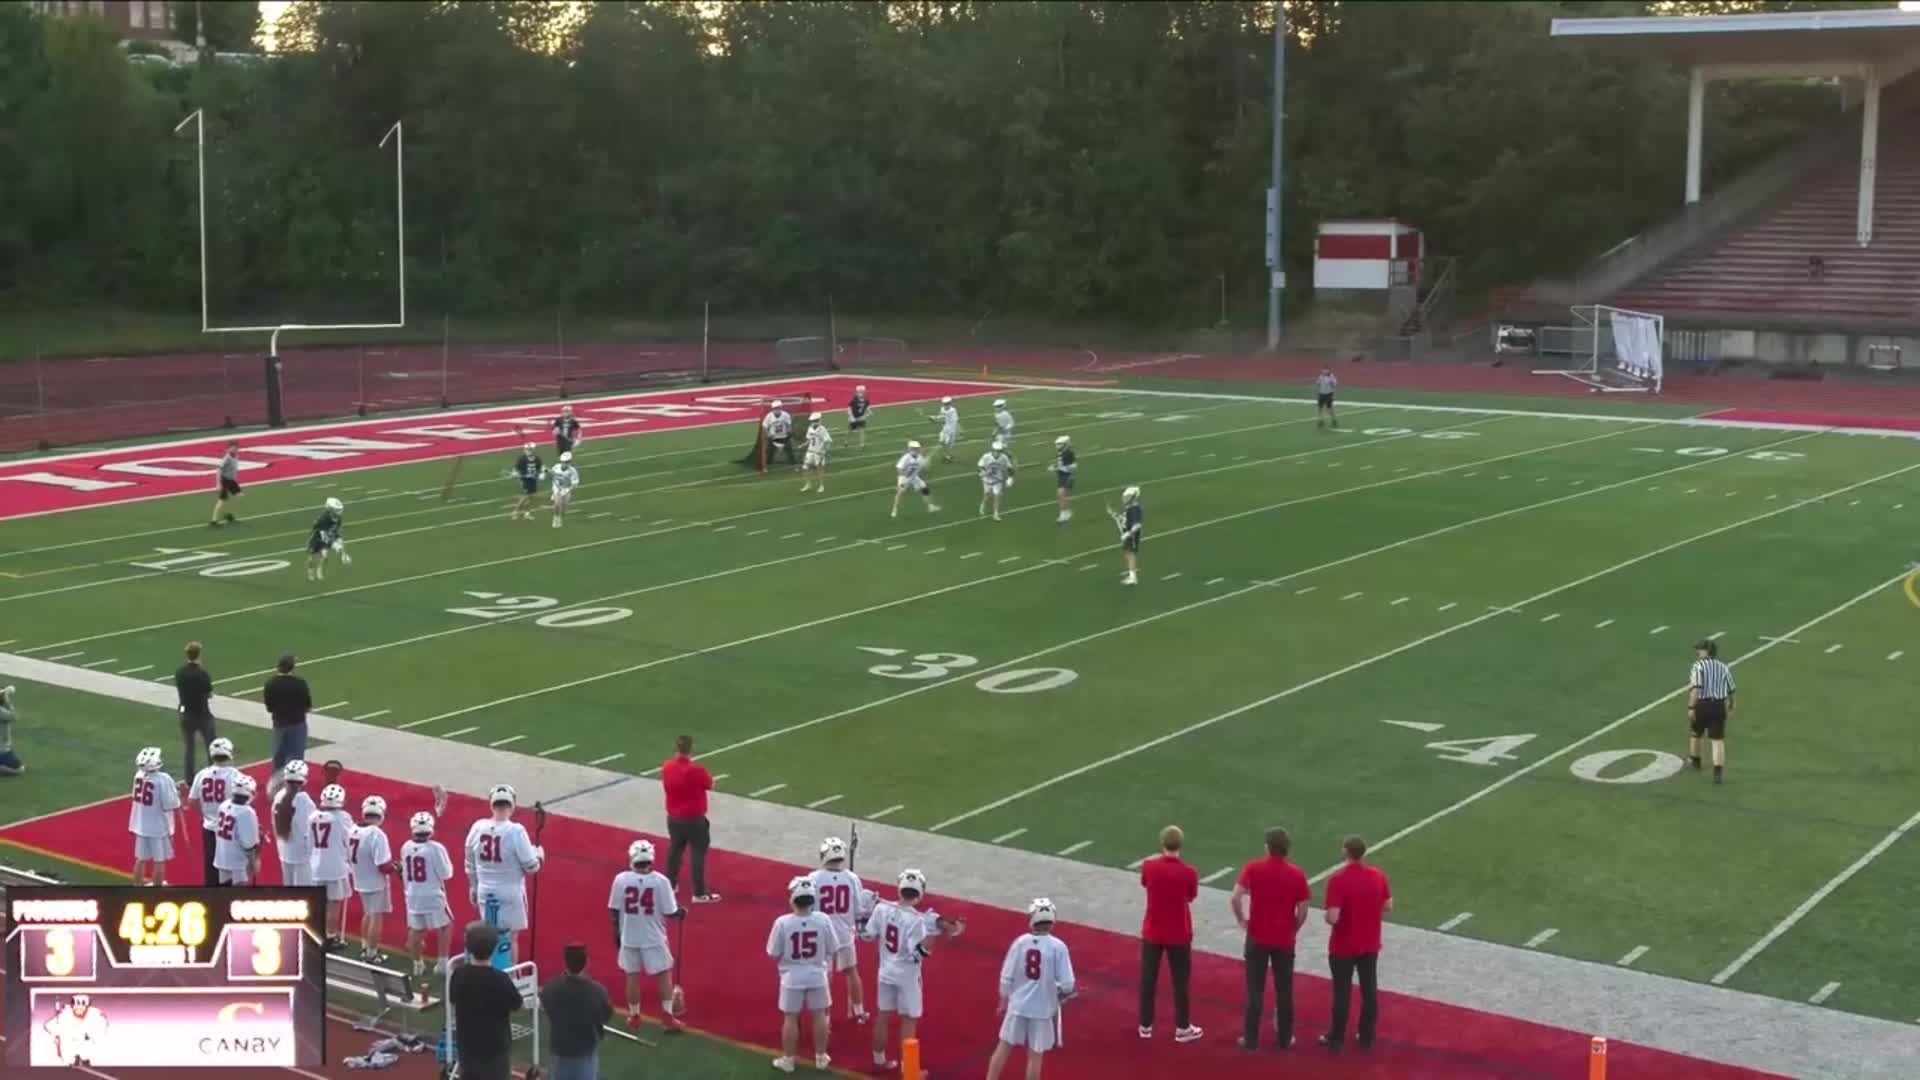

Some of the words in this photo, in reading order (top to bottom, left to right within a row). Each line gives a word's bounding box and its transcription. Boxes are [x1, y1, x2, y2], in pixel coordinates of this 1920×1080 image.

[130, 548, 291, 577] 10
[446, 594, 632, 628] 20
[868, 653, 1078, 694] 30
[1425, 733, 1685, 784] 40
[134, 777, 155, 806] 26
[202, 777, 225, 802] 28
[311, 822, 332, 848] 17
[480, 835, 502, 862] 31
[405, 856, 427, 882] 18
[625, 887, 655, 914] 24
[819, 885, 850, 914] 20
[790, 931, 818, 960] 15
[886, 925, 899, 954] 9
[1025, 949, 1041, 981] 8
